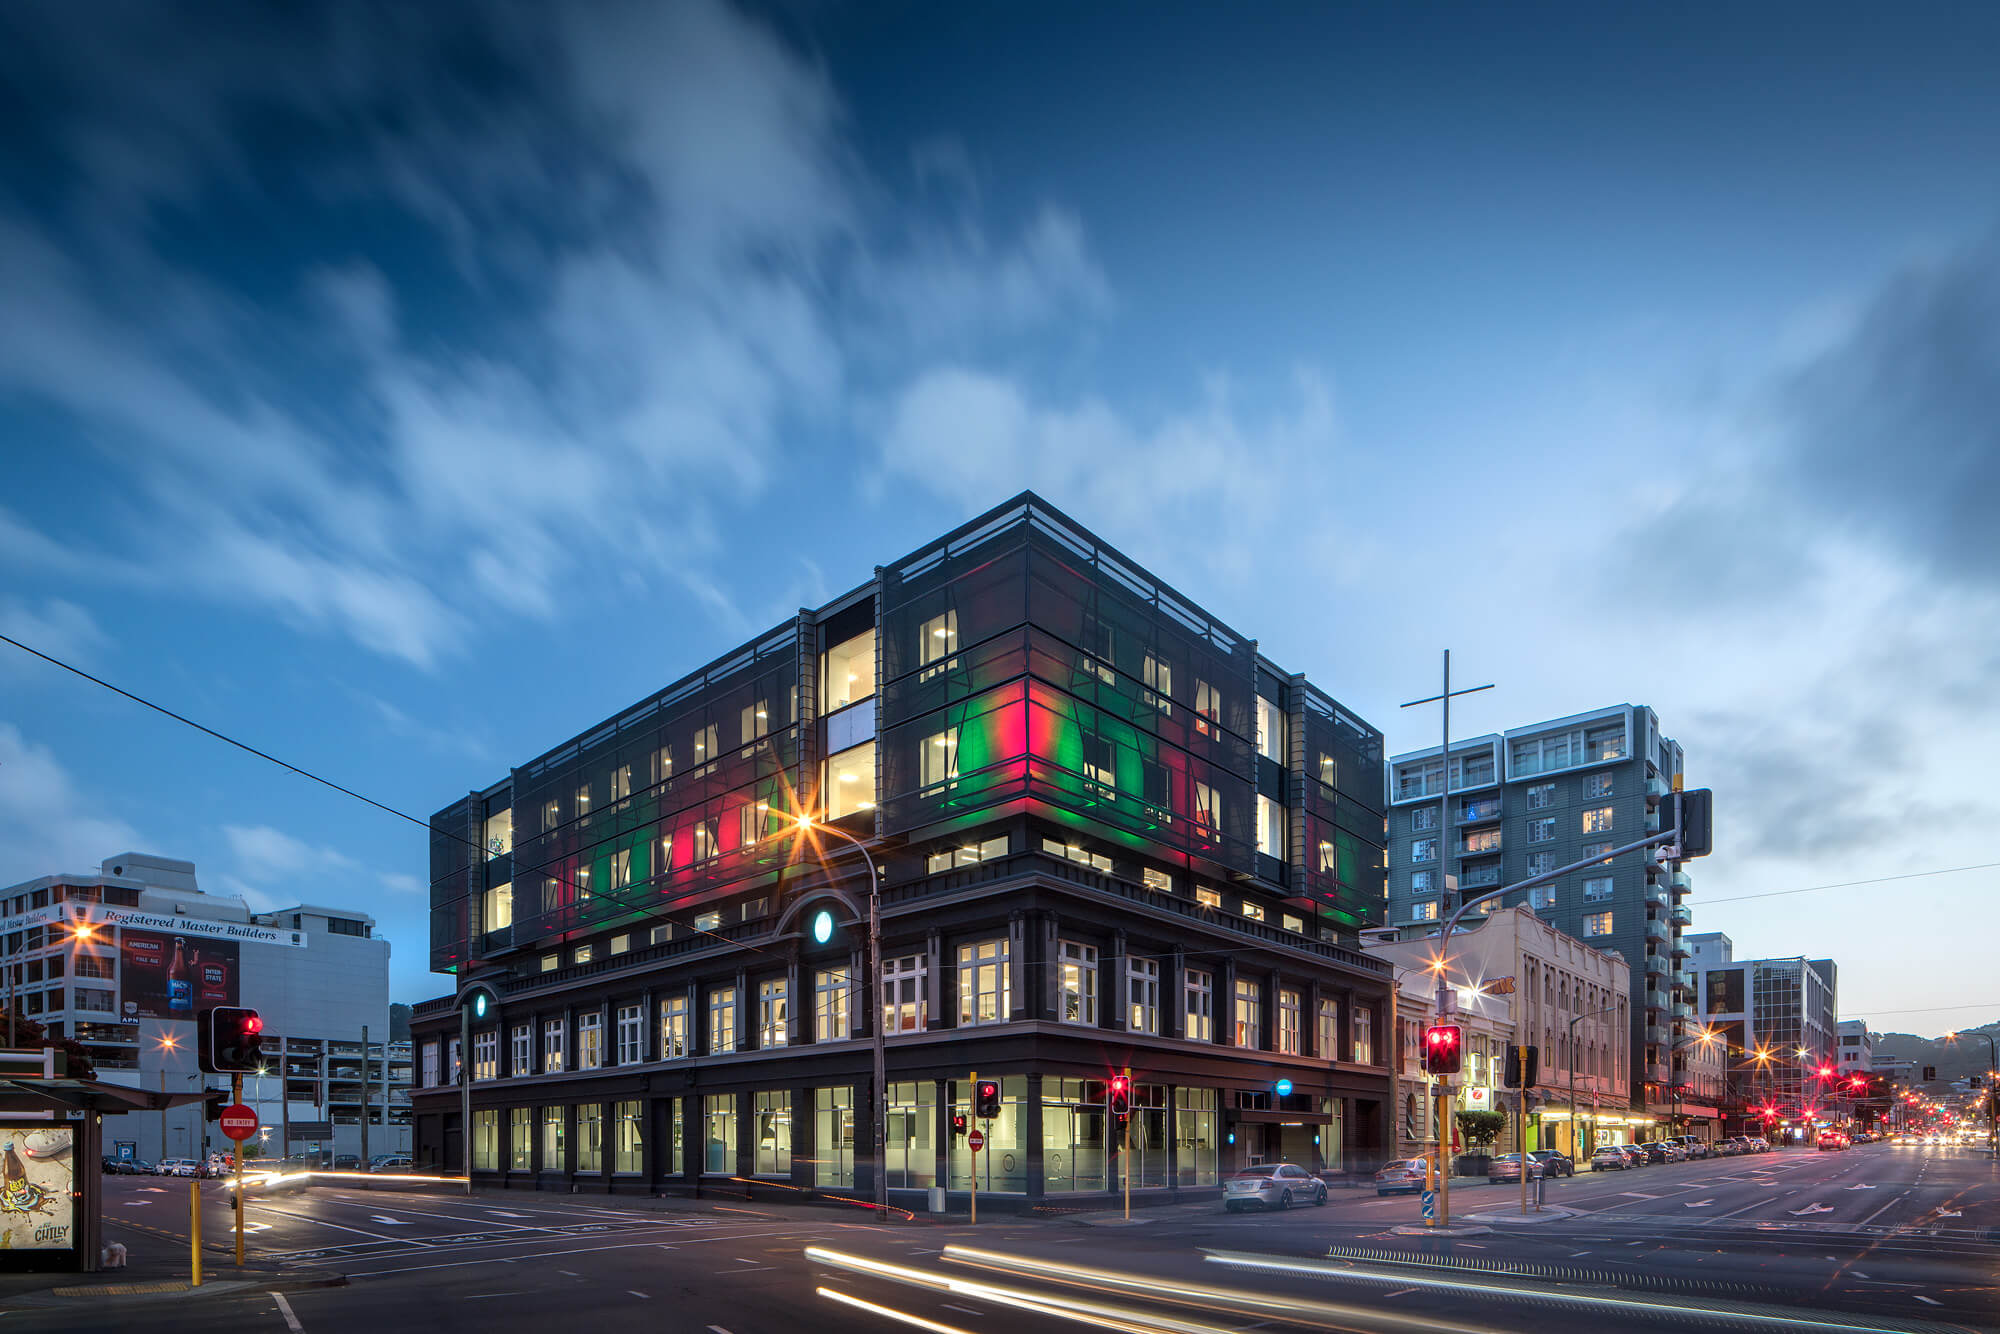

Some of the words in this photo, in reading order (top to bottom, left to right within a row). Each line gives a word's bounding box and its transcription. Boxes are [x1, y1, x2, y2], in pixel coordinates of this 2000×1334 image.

[104, 910, 175, 929] Registered
[179, 919, 223, 934] Master
[227, 925, 277, 940] Builders
[128, 941, 159, 950] AMERICAN
[121, 1147, 130, 1158] P
[35, 1225, 69, 1241] CHILLY
